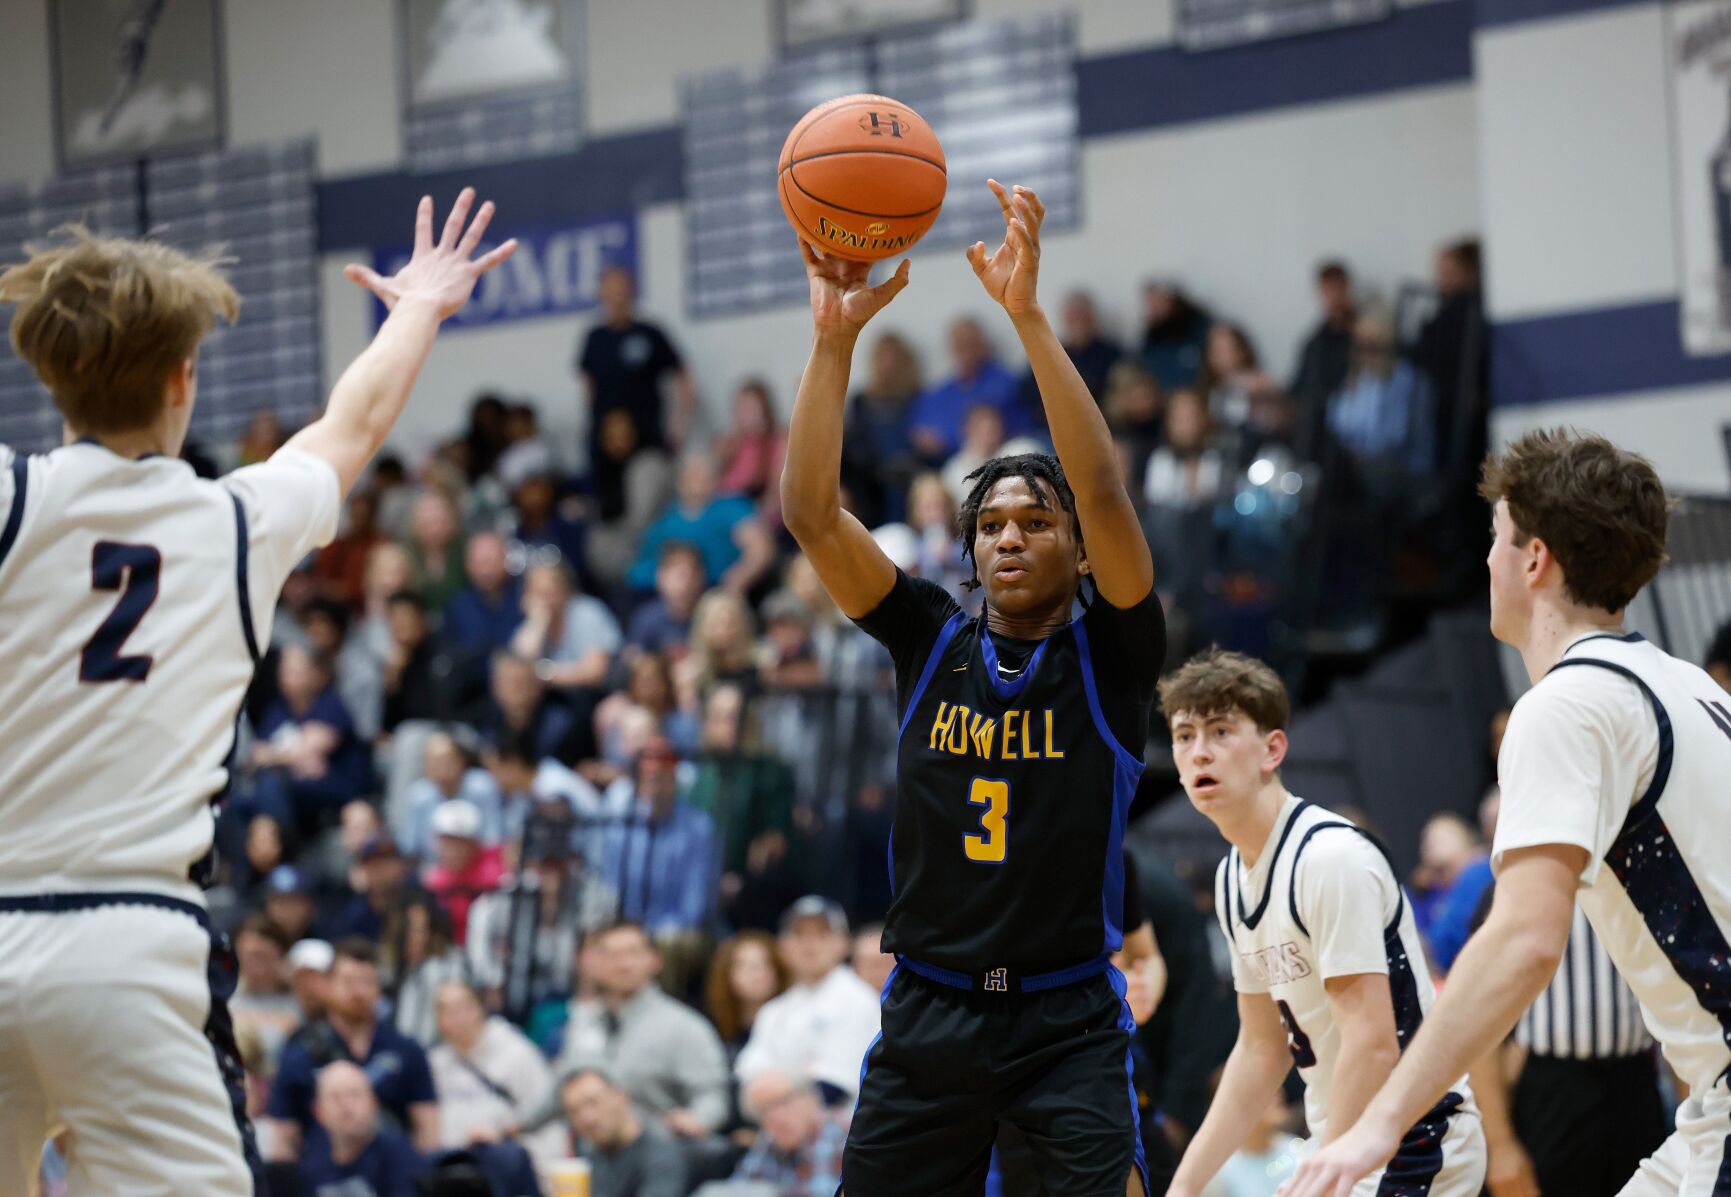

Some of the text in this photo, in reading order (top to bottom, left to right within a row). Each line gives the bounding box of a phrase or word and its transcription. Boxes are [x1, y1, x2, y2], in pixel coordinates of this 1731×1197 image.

[79, 541, 161, 683] 2
[928, 701, 1065, 760] HOWELL
[962, 775, 1012, 865] 3
[984, 968, 1008, 992] H
